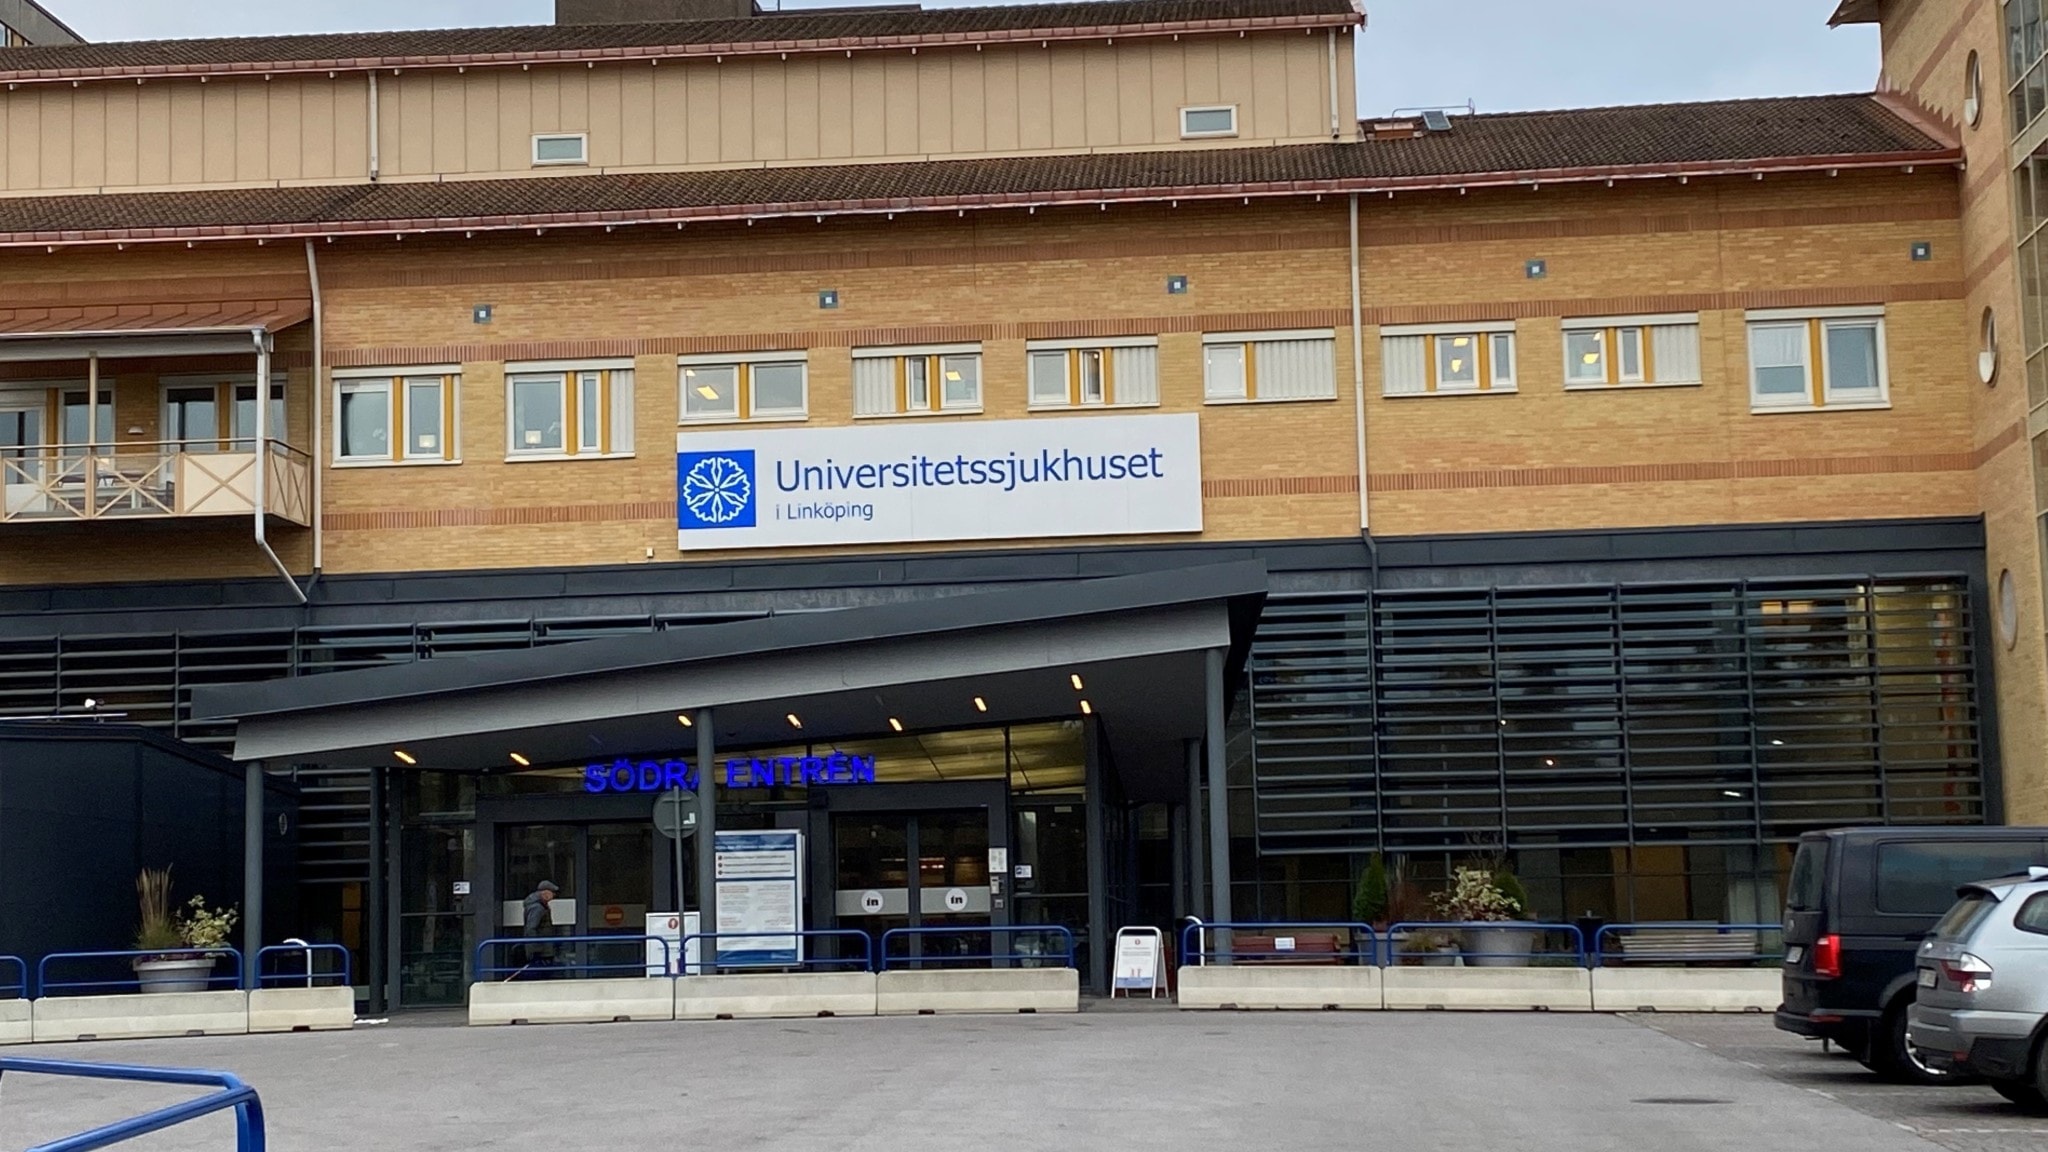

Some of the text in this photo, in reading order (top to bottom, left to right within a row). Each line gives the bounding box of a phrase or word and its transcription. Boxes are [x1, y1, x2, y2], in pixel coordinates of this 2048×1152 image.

[775, 447, 1164, 492] Universitetssjukhuset
[775, 501, 875, 523] i Linköping
[726, 751, 875, 788] ENTRÉN
